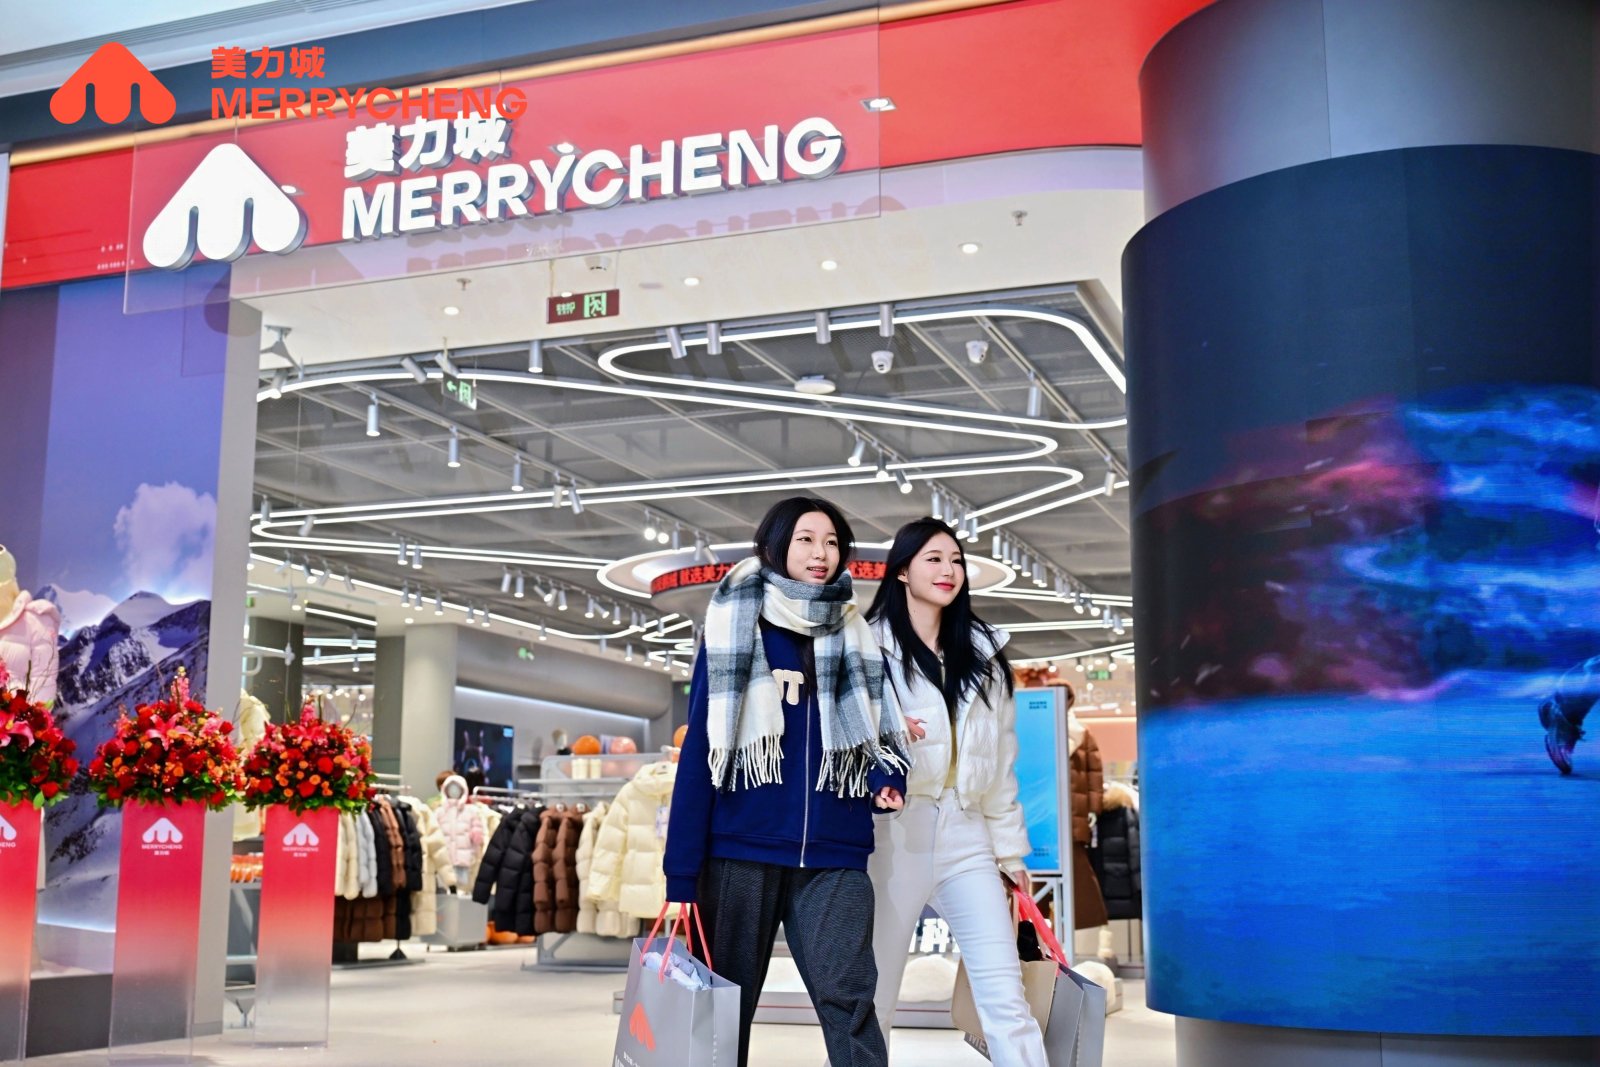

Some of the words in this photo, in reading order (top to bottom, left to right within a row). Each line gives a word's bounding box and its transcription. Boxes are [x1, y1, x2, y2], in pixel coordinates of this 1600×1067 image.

[341, 117, 844, 240] MERRYCHENG
[344, 105, 508, 178] 美力城
